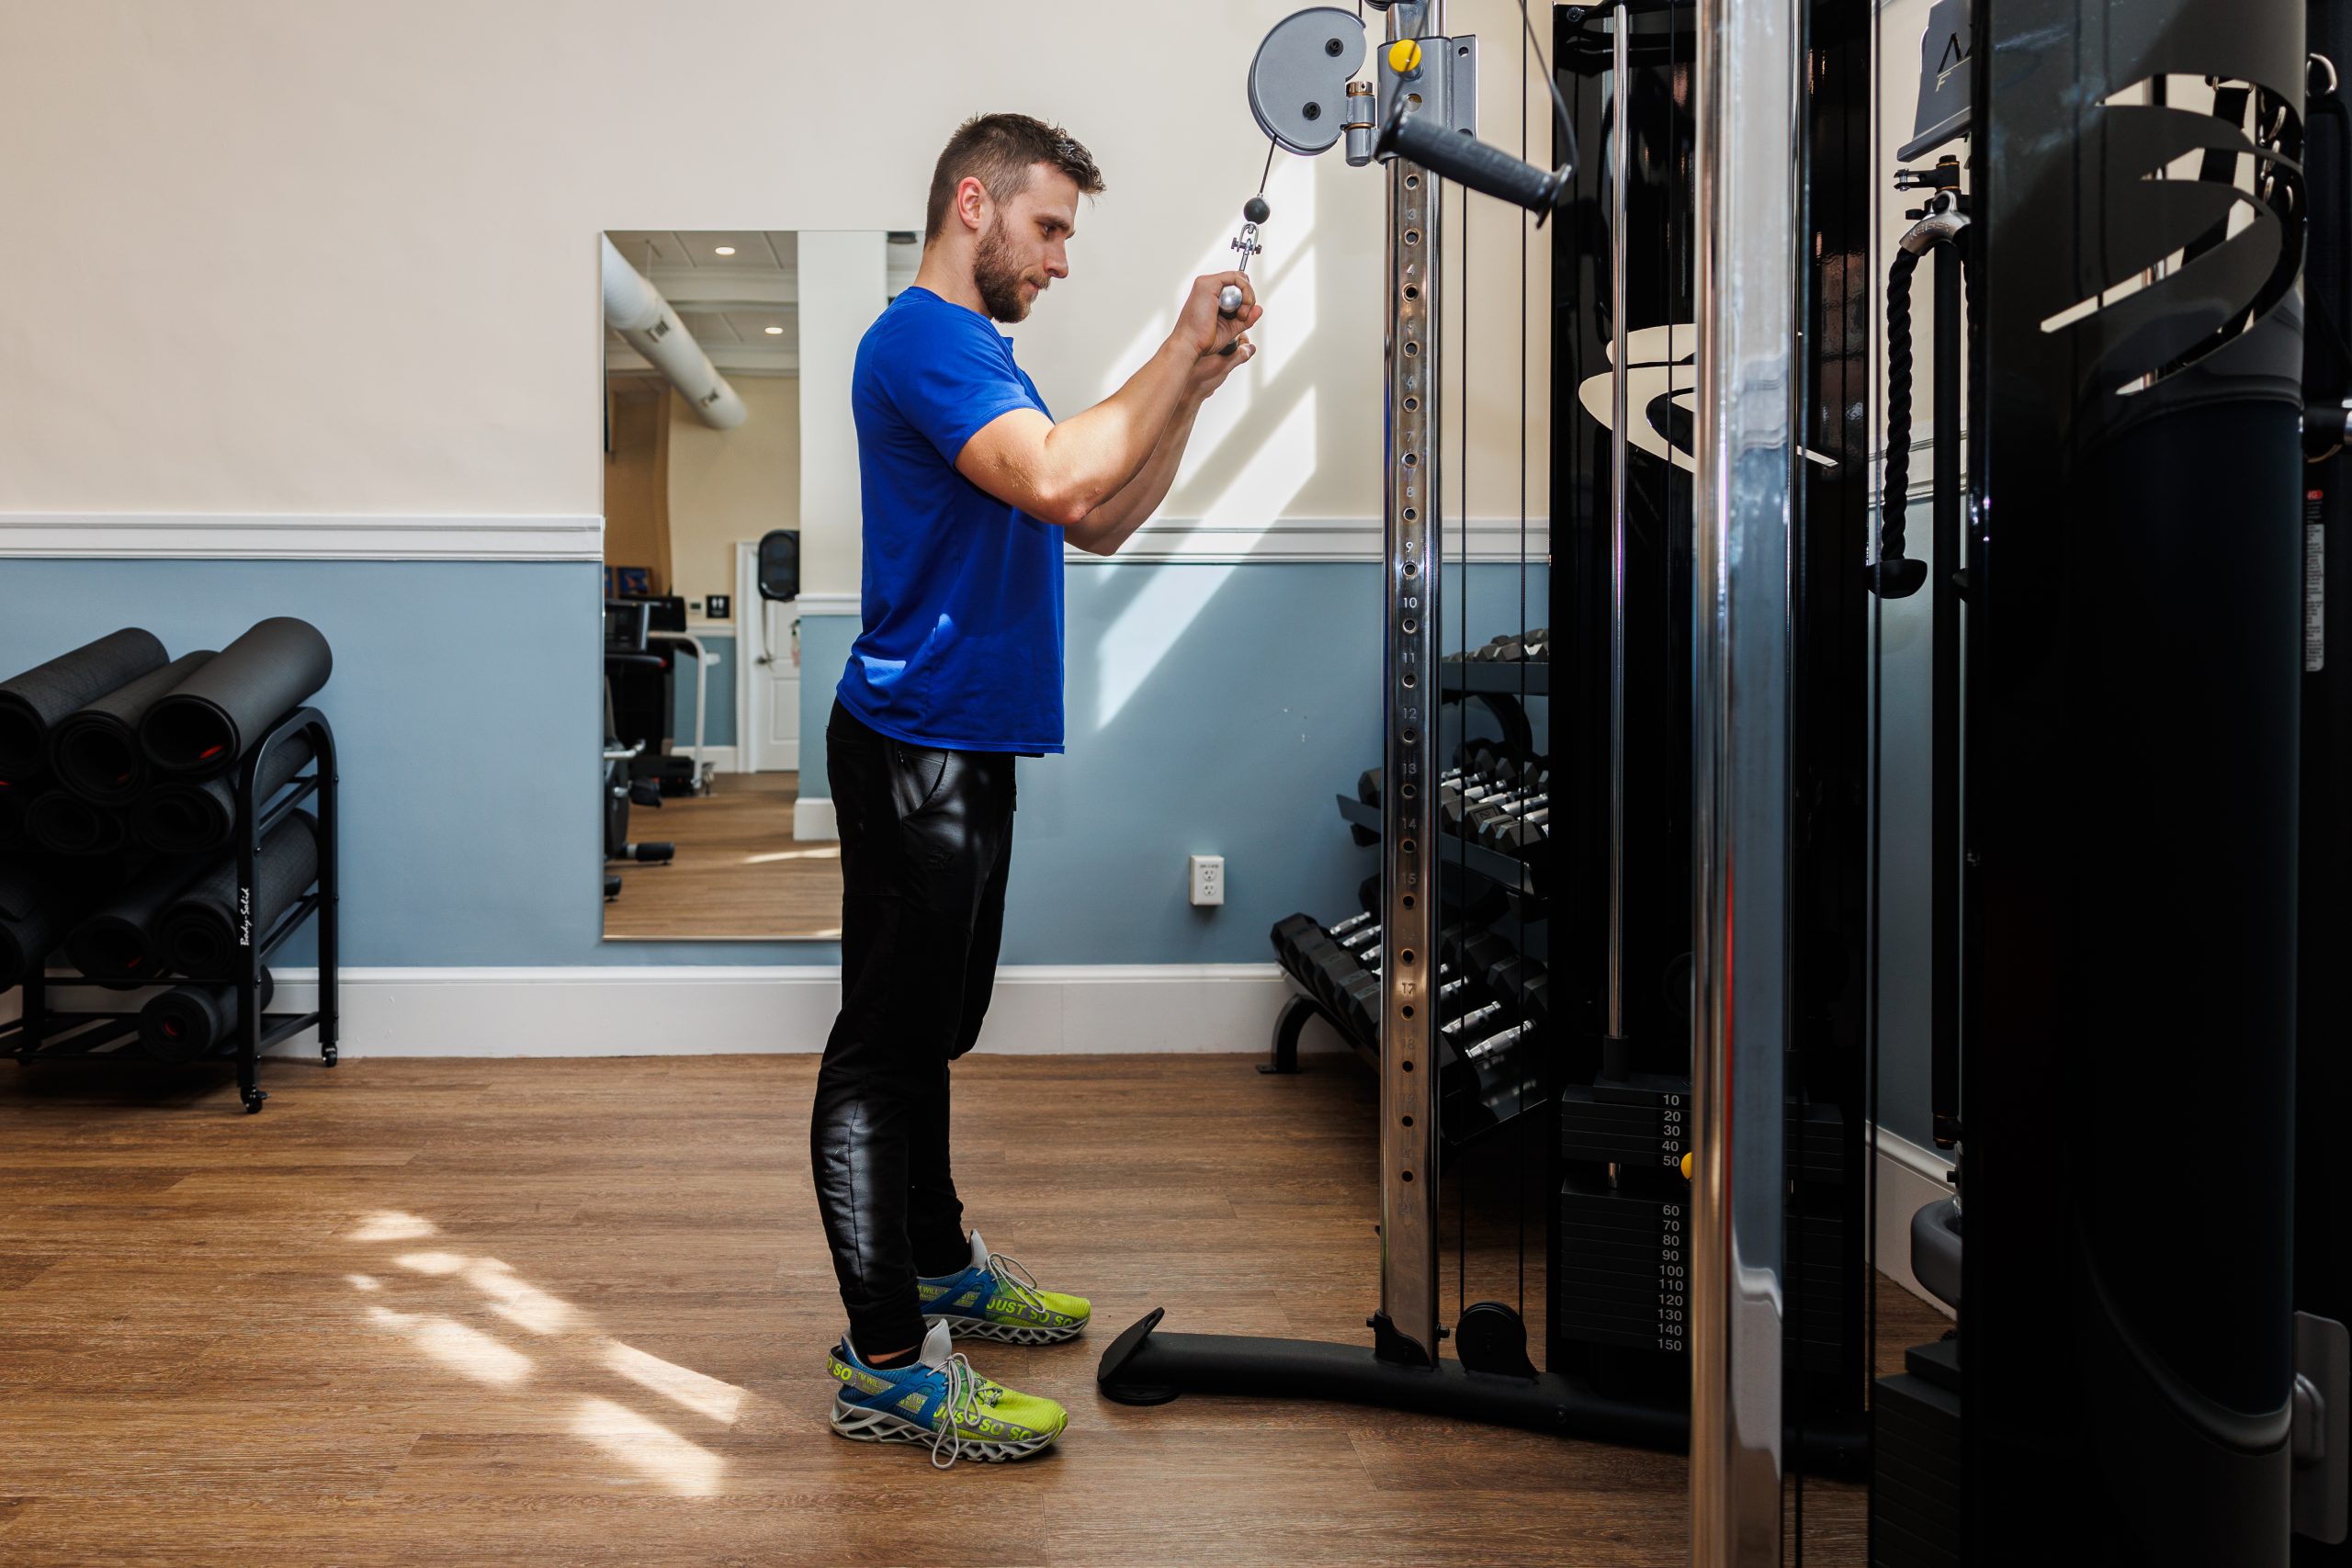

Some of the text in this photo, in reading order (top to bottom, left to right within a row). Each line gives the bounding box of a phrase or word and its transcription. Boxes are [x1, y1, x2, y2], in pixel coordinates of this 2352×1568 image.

[1407, 264, 1416, 276] 4
[1406, 431, 1414, 442] 7
[1406, 486, 1415, 498] 8
[1405, 541, 1414, 553] 9
[1403, 597, 1418, 609] 10
[1403, 652, 1416, 664] 11
[1403, 707, 1417, 719] 12
[1403, 763, 1417, 774] 13
[1402, 818, 1417, 829] 14
[1402, 983, 1416, 995] 17
[1663, 1094, 1679, 1106] 10
[1664, 1111, 1681, 1122] 20
[1663, 1125, 1680, 1137] 30
[1662, 1140, 1679, 1152] 40
[1663, 1156, 1680, 1167] 50
[1663, 1205, 1679, 1216] 60
[1663, 1220, 1679, 1232] 70
[1663, 1235, 1679, 1247] 80
[1662, 1250, 1679, 1261] 90
[1658, 1265, 1684, 1278] 100
[1658, 1279, 1683, 1292] 110
[1658, 1294, 1683, 1306] 120
[986, 1298, 1027, 1315] JUST
[1030, 1310, 1050, 1323] SO
[1657, 1309, 1682, 1322] 130
[1657, 1324, 1682, 1337] 140
[1657, 1338, 1682, 1351] 150
[832, 1363, 853, 1381] SO
[979, 1418, 1004, 1436] SO
